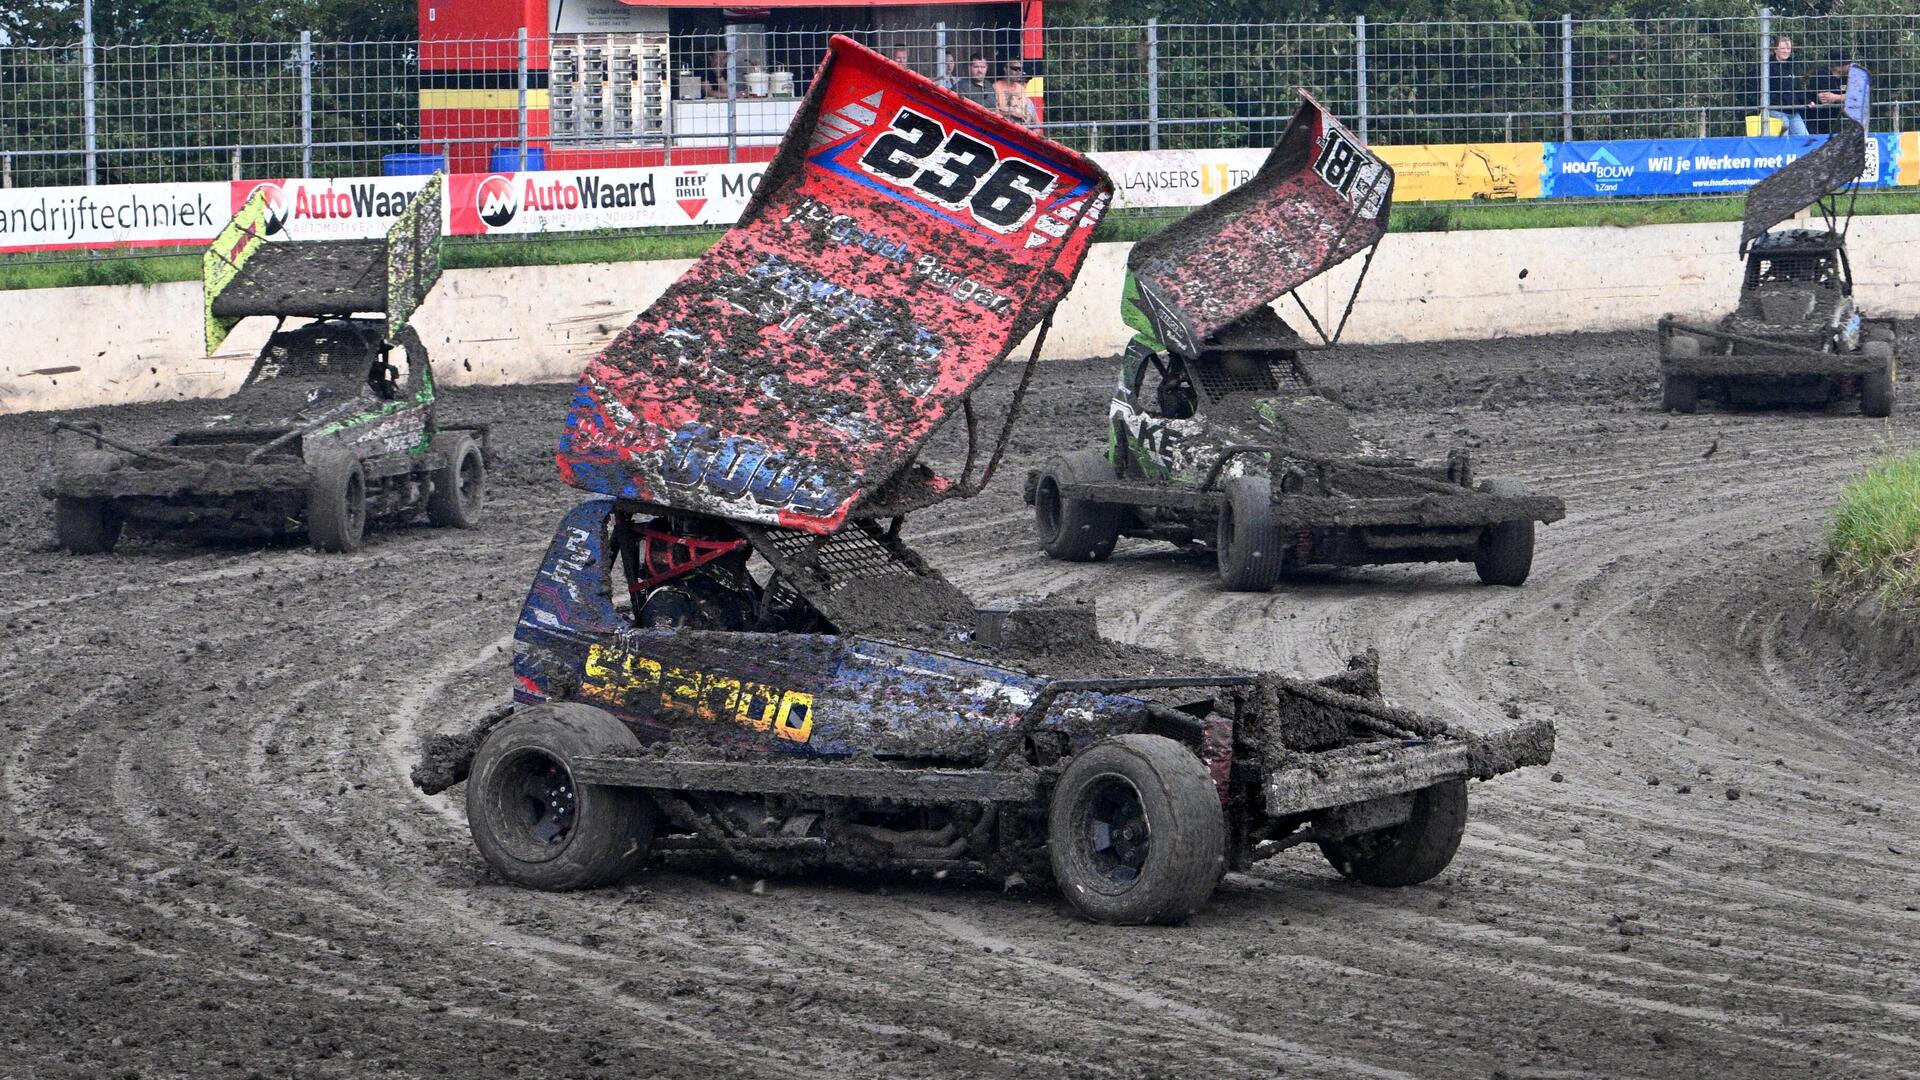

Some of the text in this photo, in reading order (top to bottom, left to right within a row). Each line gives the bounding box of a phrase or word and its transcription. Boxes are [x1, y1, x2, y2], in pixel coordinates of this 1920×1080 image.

[859, 106, 1059, 234] 236
[1313, 128, 1366, 202] 181
[1647, 157, 1673, 172] Wil
[1675, 157, 1691, 175] je
[1695, 155, 1751, 170] Werken
[1754, 154, 1783, 168] met
[675, 176, 706, 187] DEEP
[1124, 170, 1199, 190] LANSERS
[523, 173, 656, 211] AutoWaard
[676, 188, 705, 197] DRILL
